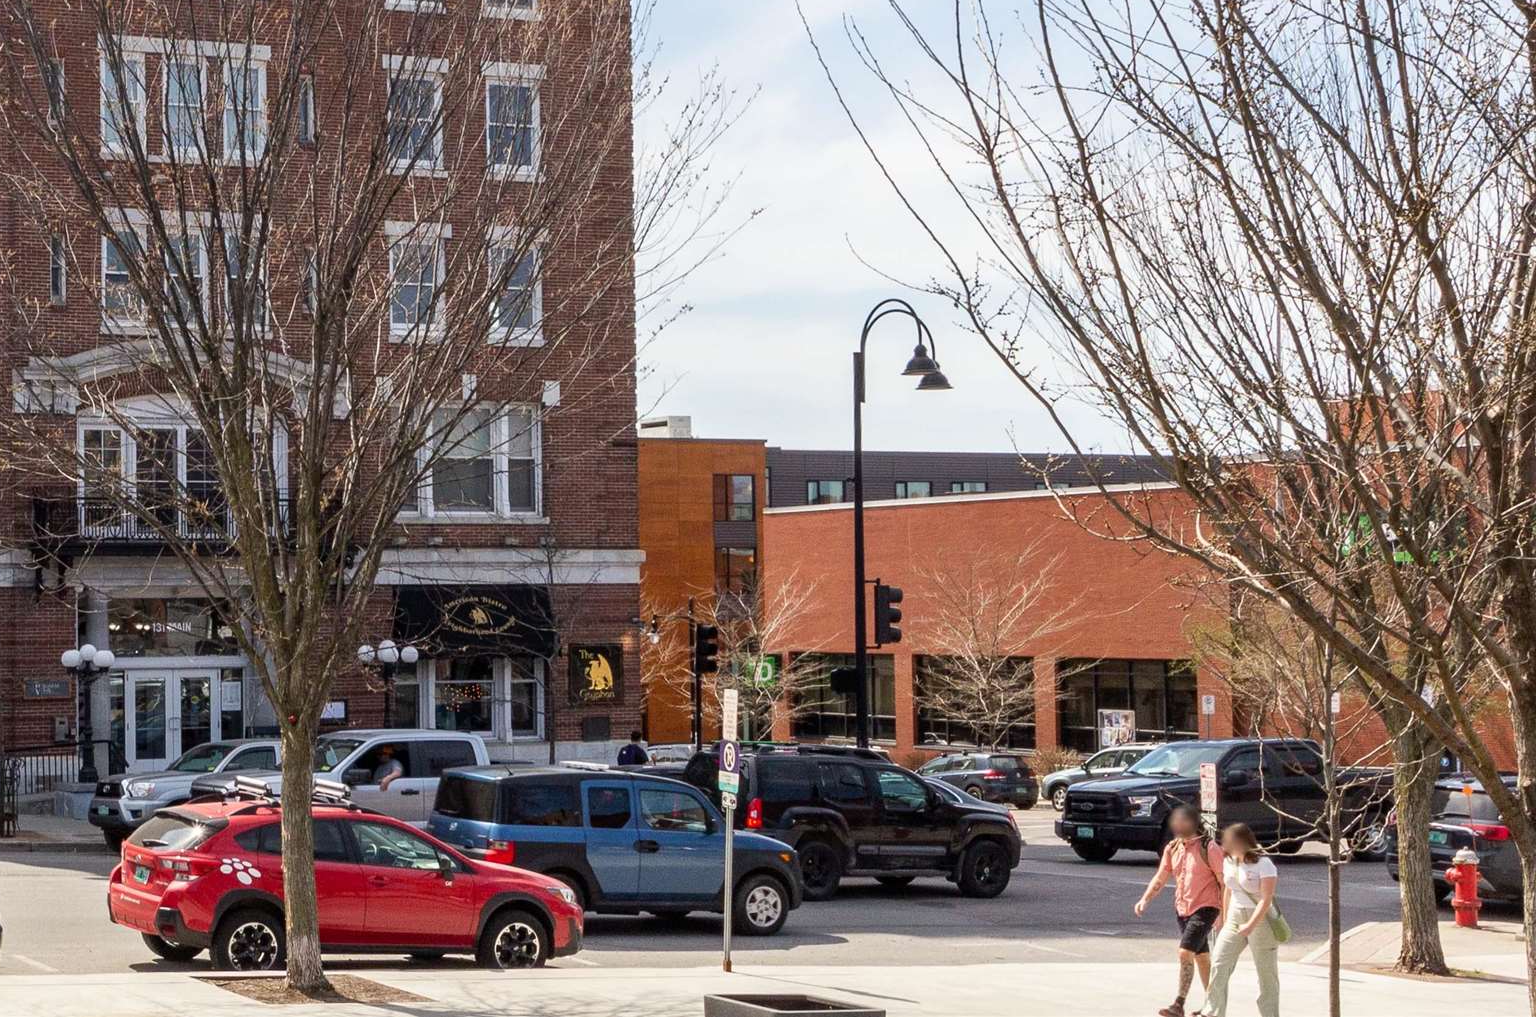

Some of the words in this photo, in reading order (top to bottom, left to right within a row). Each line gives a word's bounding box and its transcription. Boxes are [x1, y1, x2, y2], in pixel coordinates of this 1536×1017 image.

[152, 621, 166, 633] 131
[166, 621, 193, 633] MAIN
[578, 648, 595, 660] The
